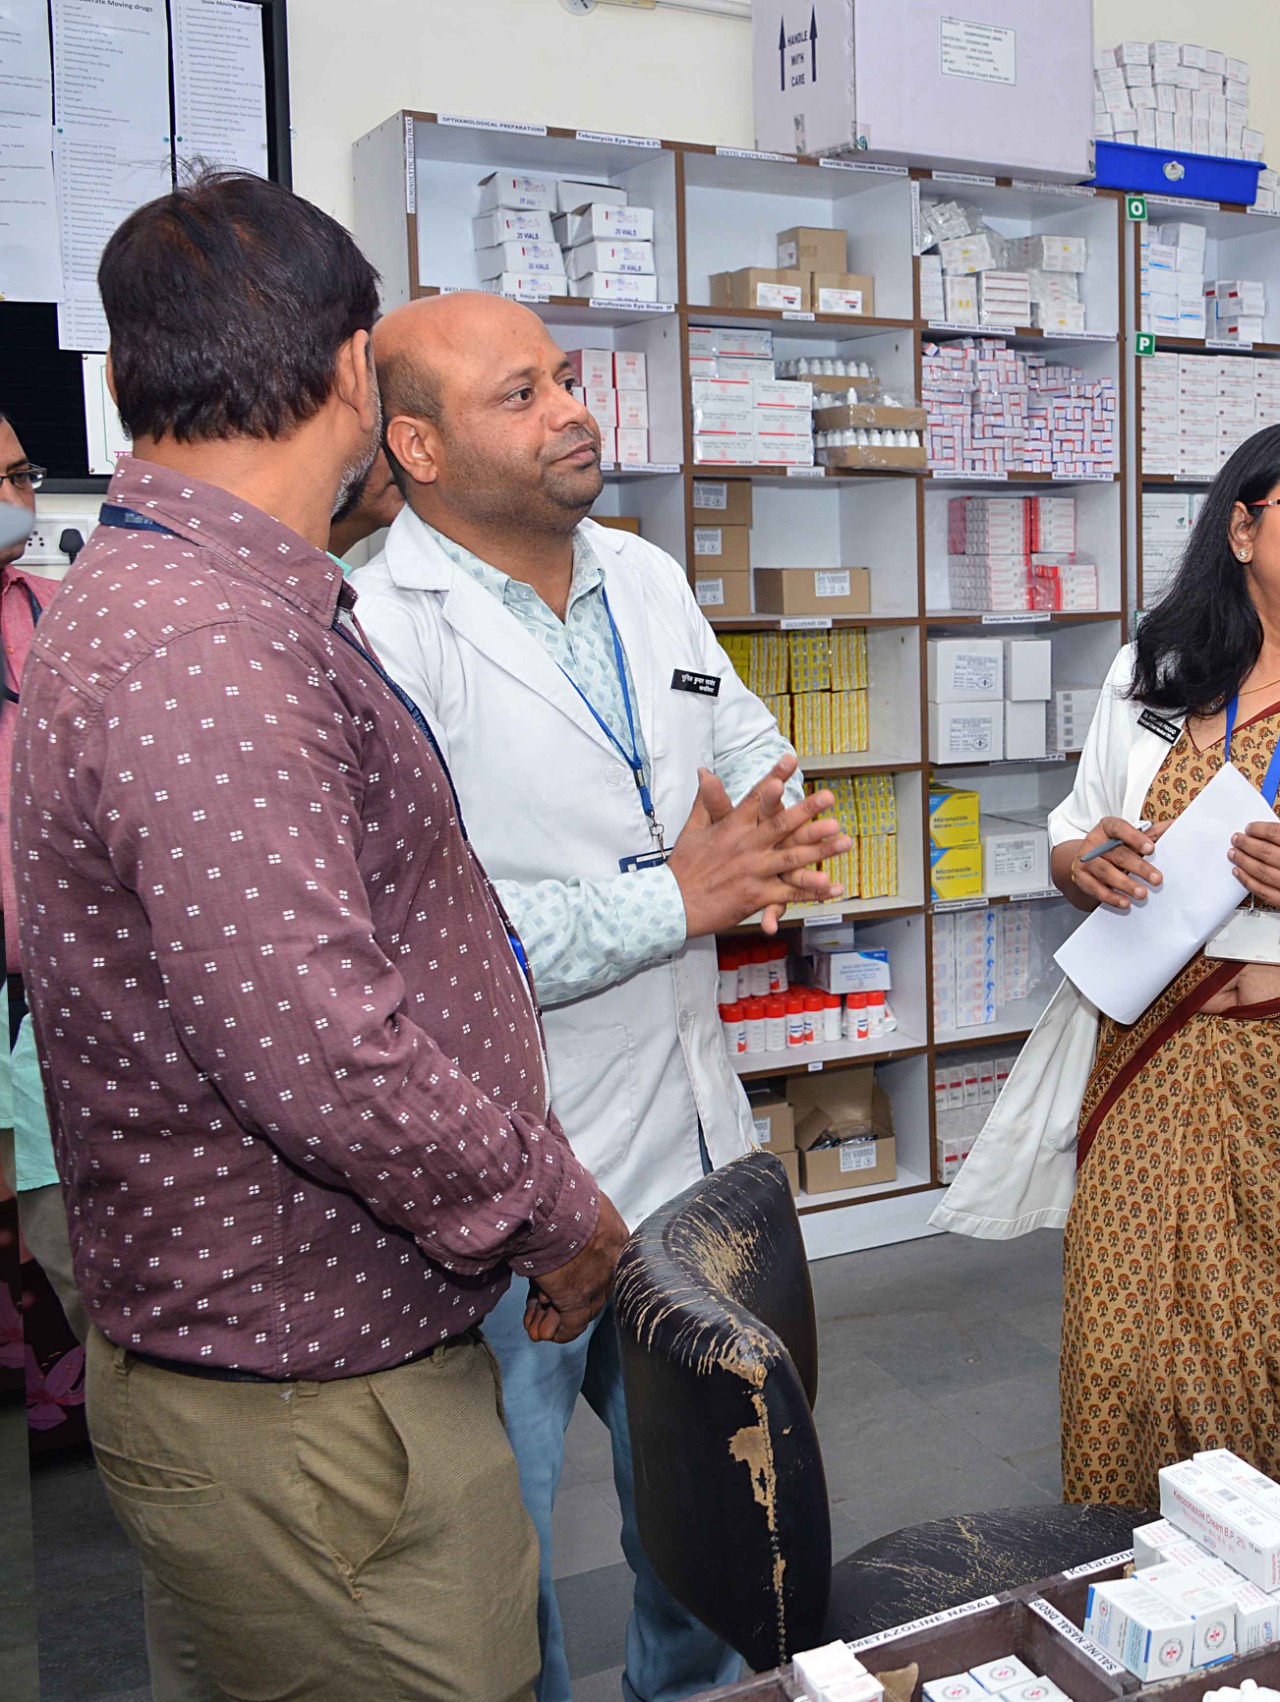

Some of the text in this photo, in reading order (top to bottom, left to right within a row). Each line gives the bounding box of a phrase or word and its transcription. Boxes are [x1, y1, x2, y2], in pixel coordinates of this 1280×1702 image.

[134, 4, 153, 13] drugs
[788, 30, 808, 47] HANDLE
[791, 53, 805, 65] WITH
[791, 73, 805, 87] CARE
[500, 123, 545, 133] PREPARATIONS
[614, 138, 626, 146] Eye
[628, 138, 645, 147] Drops
[1132, 202, 1143, 216] O
[524, 232, 540, 241] VIALS
[622, 228, 638, 237] VIALS
[536, 263, 550, 271] VIALS
[627, 264, 642, 272] VIALS
[1140, 338, 1150, 351] P
[934, 815, 969, 823] Miconazole
[936, 866, 972, 875] Miconazole
[1174, 1488, 1206, 1520] Ketoconazole
[1206, 1514, 1224, 1534] Cream
[1236, 1536, 1247, 1550] 2%
[847, 1598, 995, 1650] METAZOLINE NASAL
[1034, 1601, 1117, 1671] SALINE NASAL DROP
